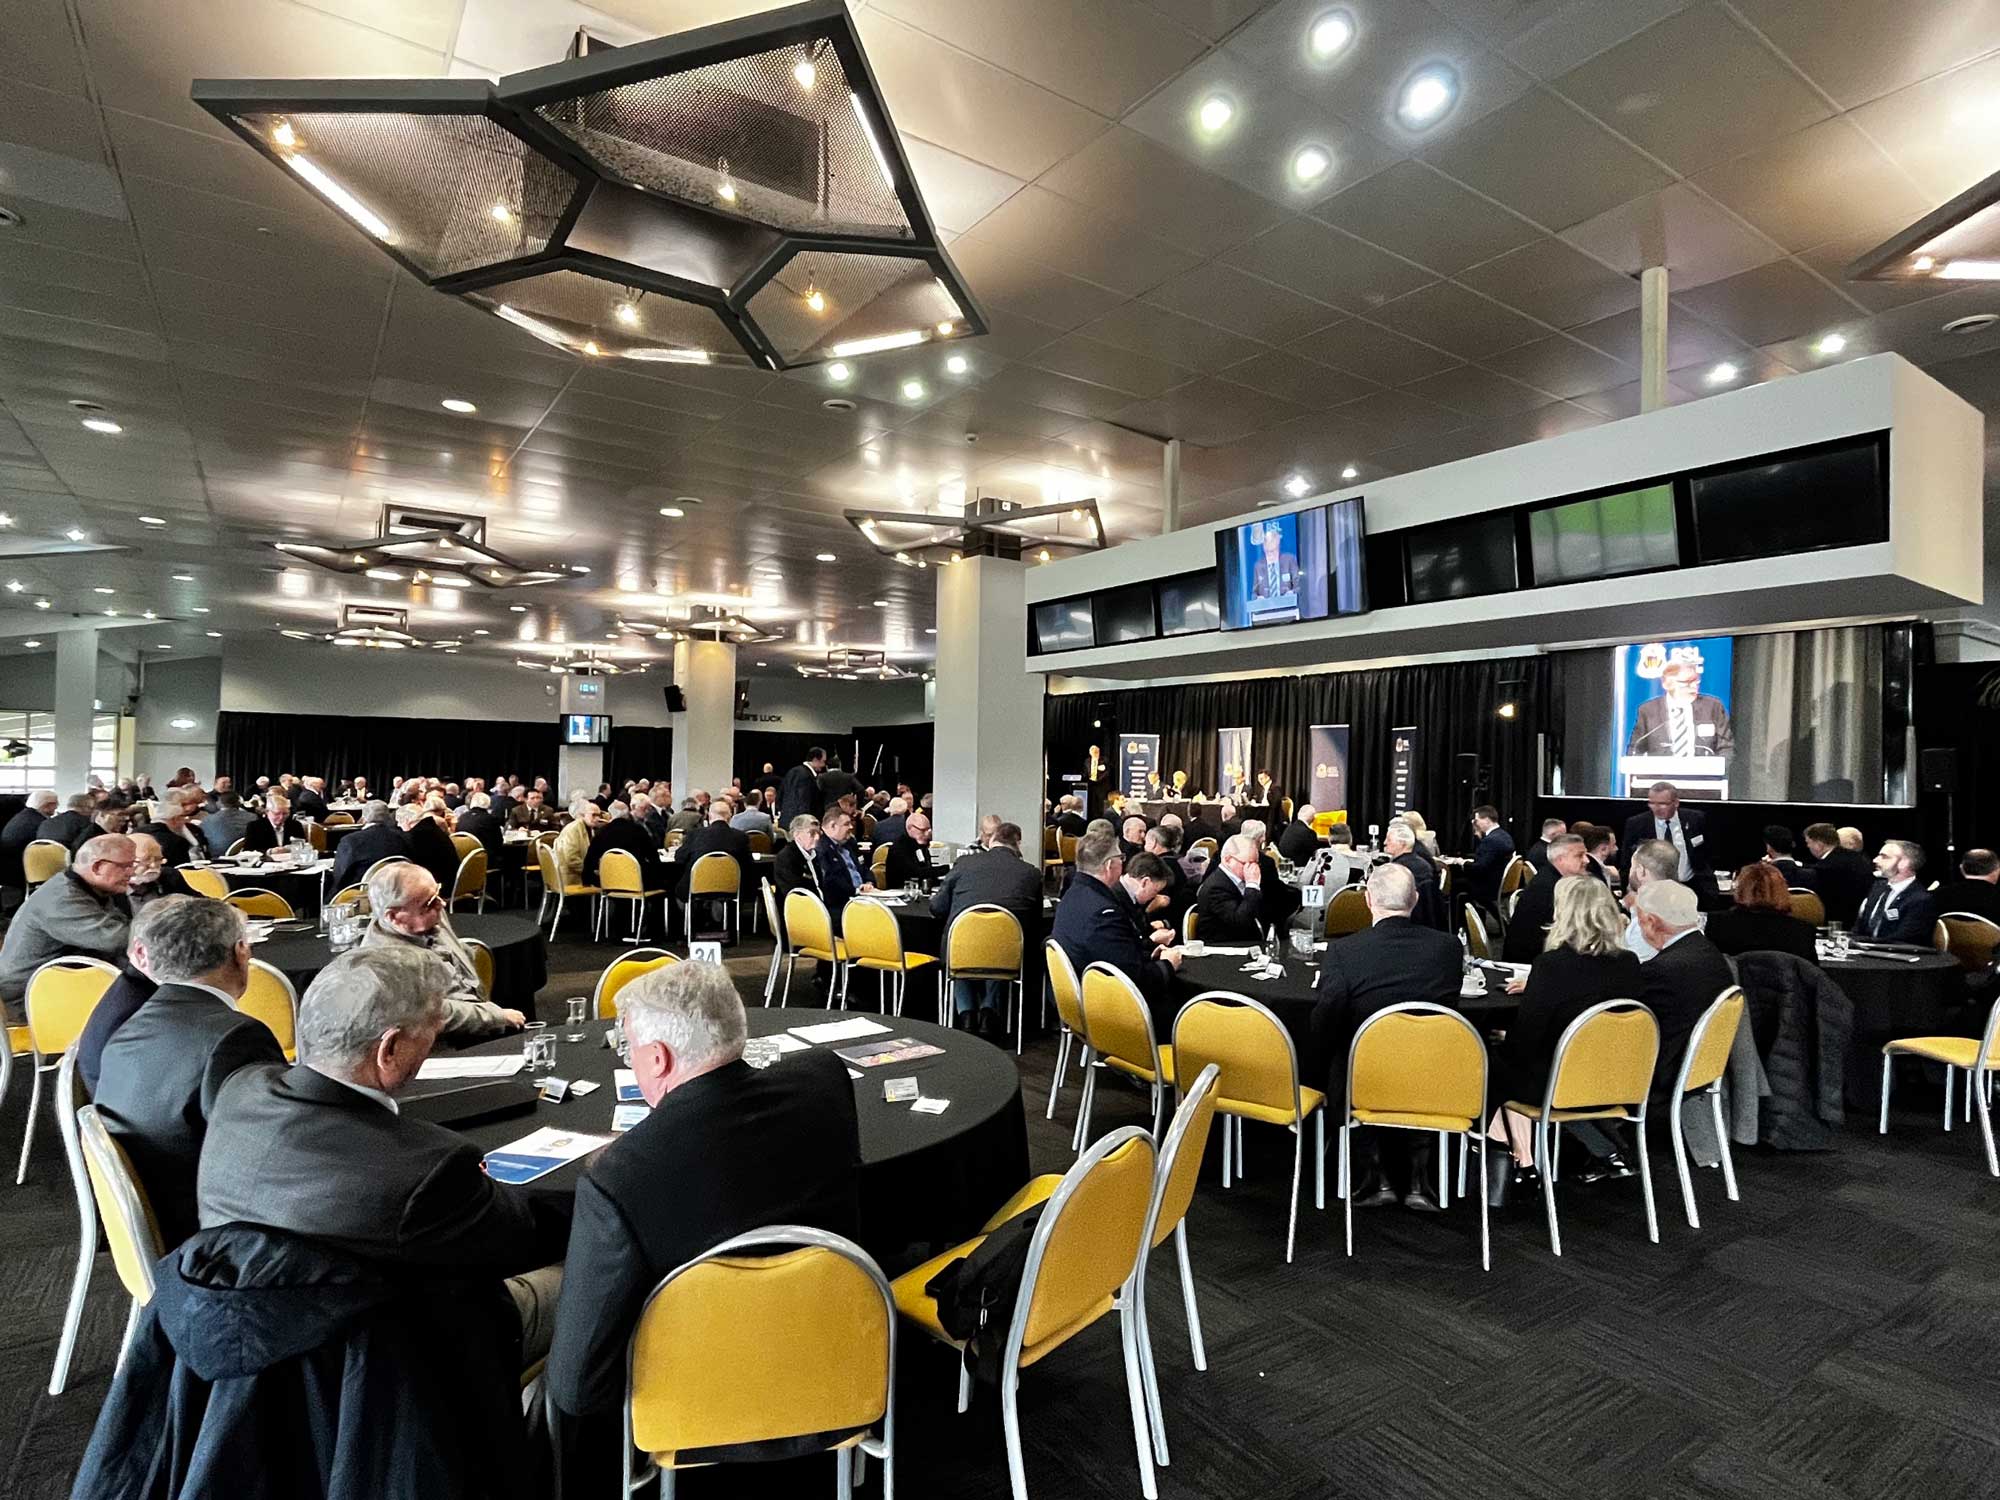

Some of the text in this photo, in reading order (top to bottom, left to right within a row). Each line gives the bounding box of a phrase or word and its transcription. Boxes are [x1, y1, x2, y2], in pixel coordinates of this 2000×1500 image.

[1266, 521, 1282, 532] RSL
[1671, 646, 1704, 665] RSL
[760, 714, 782, 722] LUCK
[1306, 888, 1319, 902] 17
